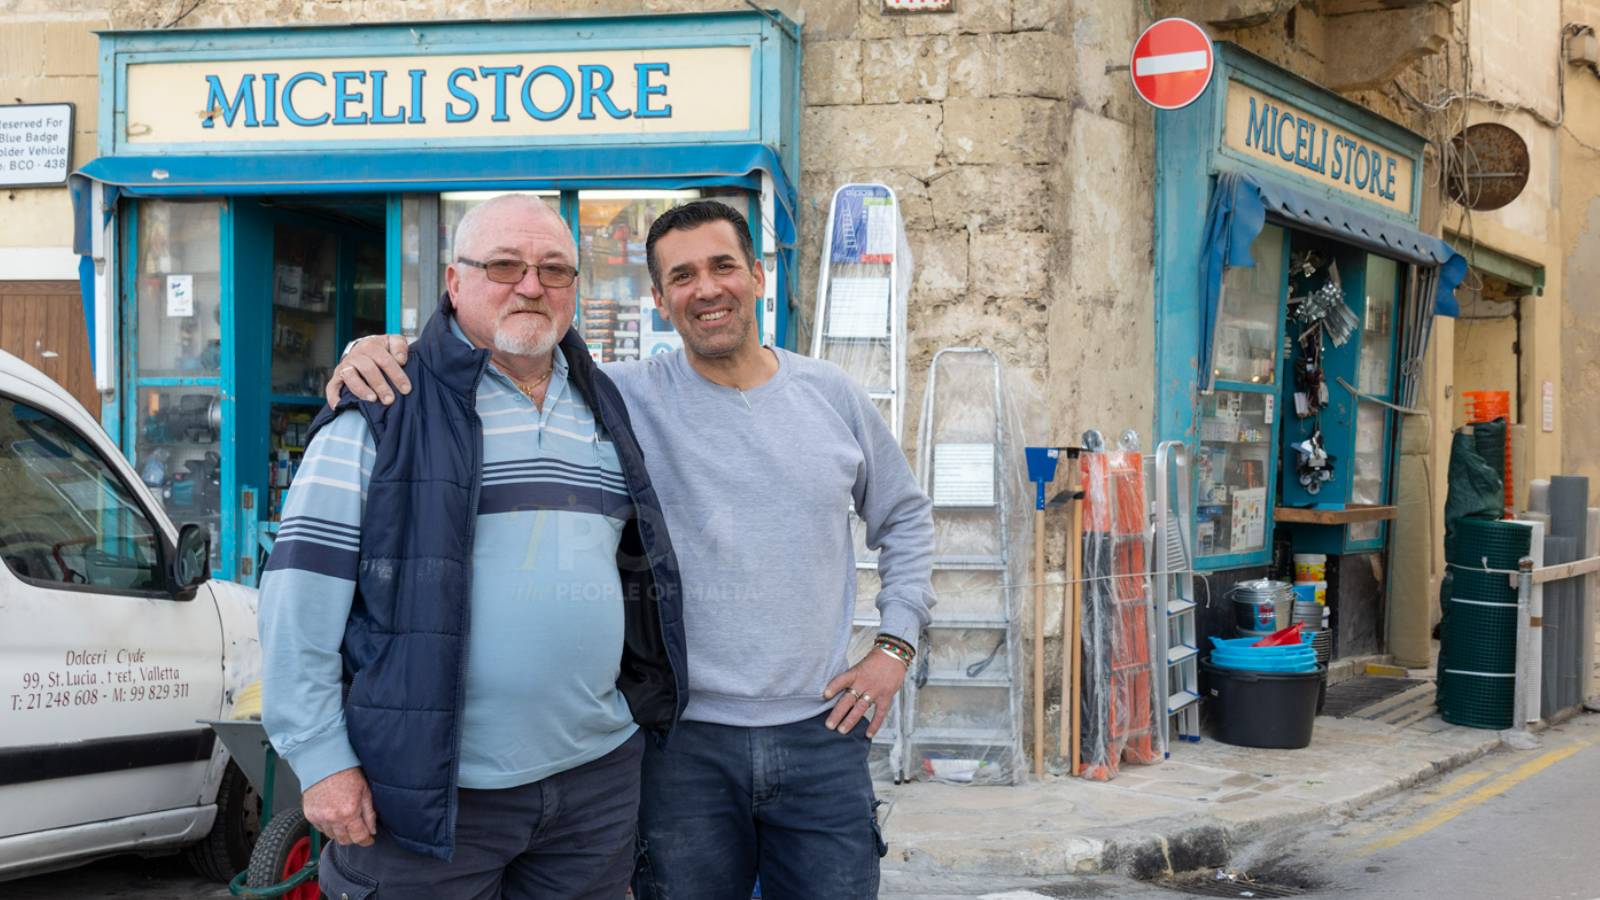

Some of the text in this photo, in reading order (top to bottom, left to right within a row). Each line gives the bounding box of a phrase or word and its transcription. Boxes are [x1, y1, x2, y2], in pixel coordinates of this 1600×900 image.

[202, 62, 673, 129] MICELI STORE
[0, 118, 63, 129] eserved For
[0, 132, 58, 143] Blue Badge
[0, 146, 65, 157] older Vehicle
[1246, 96, 1397, 201] MICELI STORE
[10, 160, 34, 170] BCO
[44, 159, 65, 169] 438
[116, 648, 146, 667] Cyde
[23, 672, 44, 690] 99,
[48, 671, 65, 688] St.
[66, 669, 98, 687] Lucia
[10, 694, 22, 711] T:
[26, 693, 41, 710] 21
[45, 691, 71, 708] 248
[74, 688, 98, 706] 608
[112, 687, 127, 703] M:
[129, 685, 145, 702] 99
[148, 683, 170, 701] 829
[172, 682, 190, 698] 311
